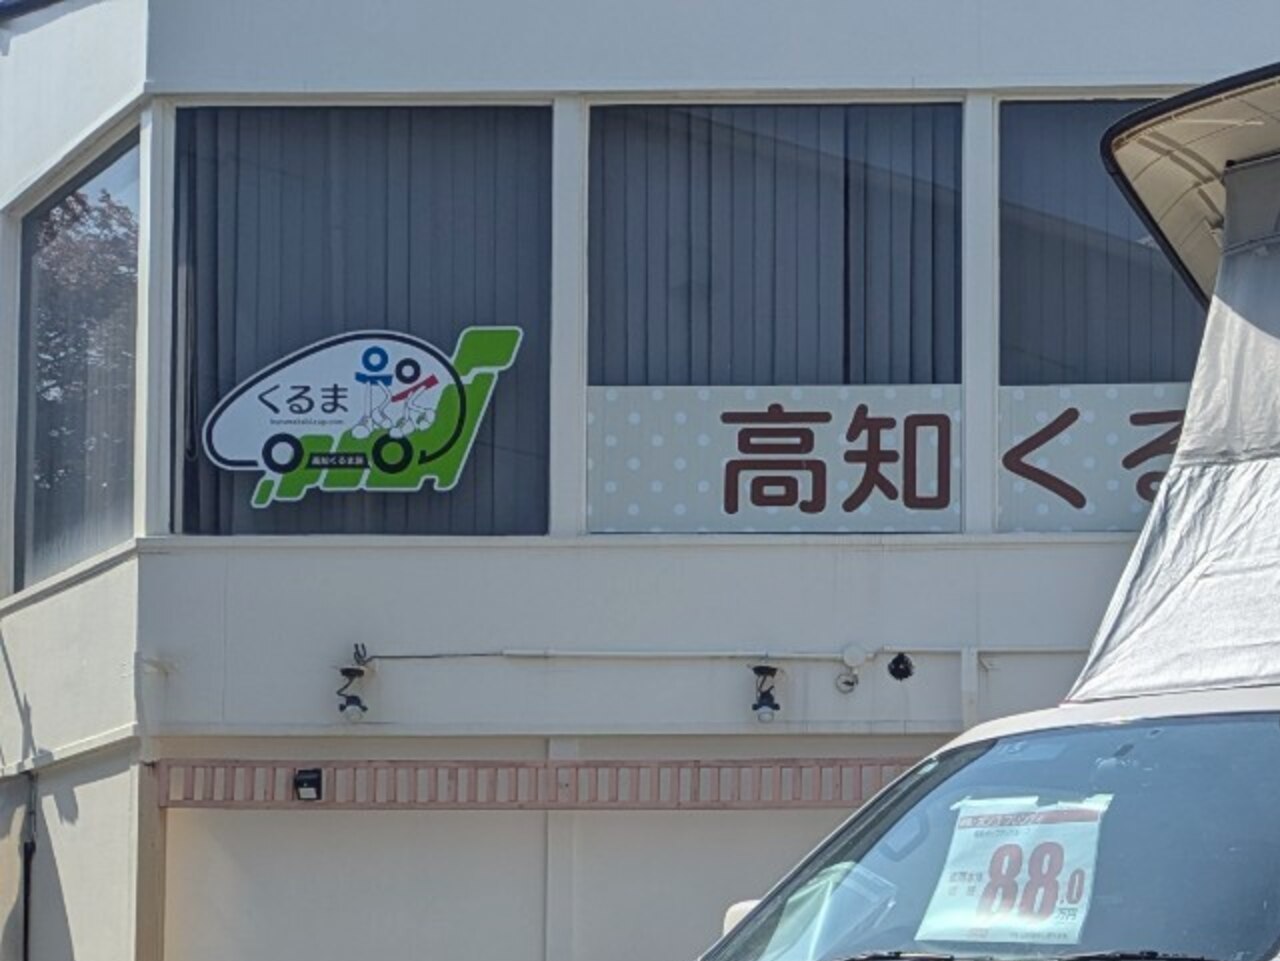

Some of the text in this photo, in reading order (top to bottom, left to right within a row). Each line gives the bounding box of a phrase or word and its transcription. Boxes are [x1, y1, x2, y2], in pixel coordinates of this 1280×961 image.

[257, 383, 349, 414] くるま
[976, 841, 1086, 923] 88.0
